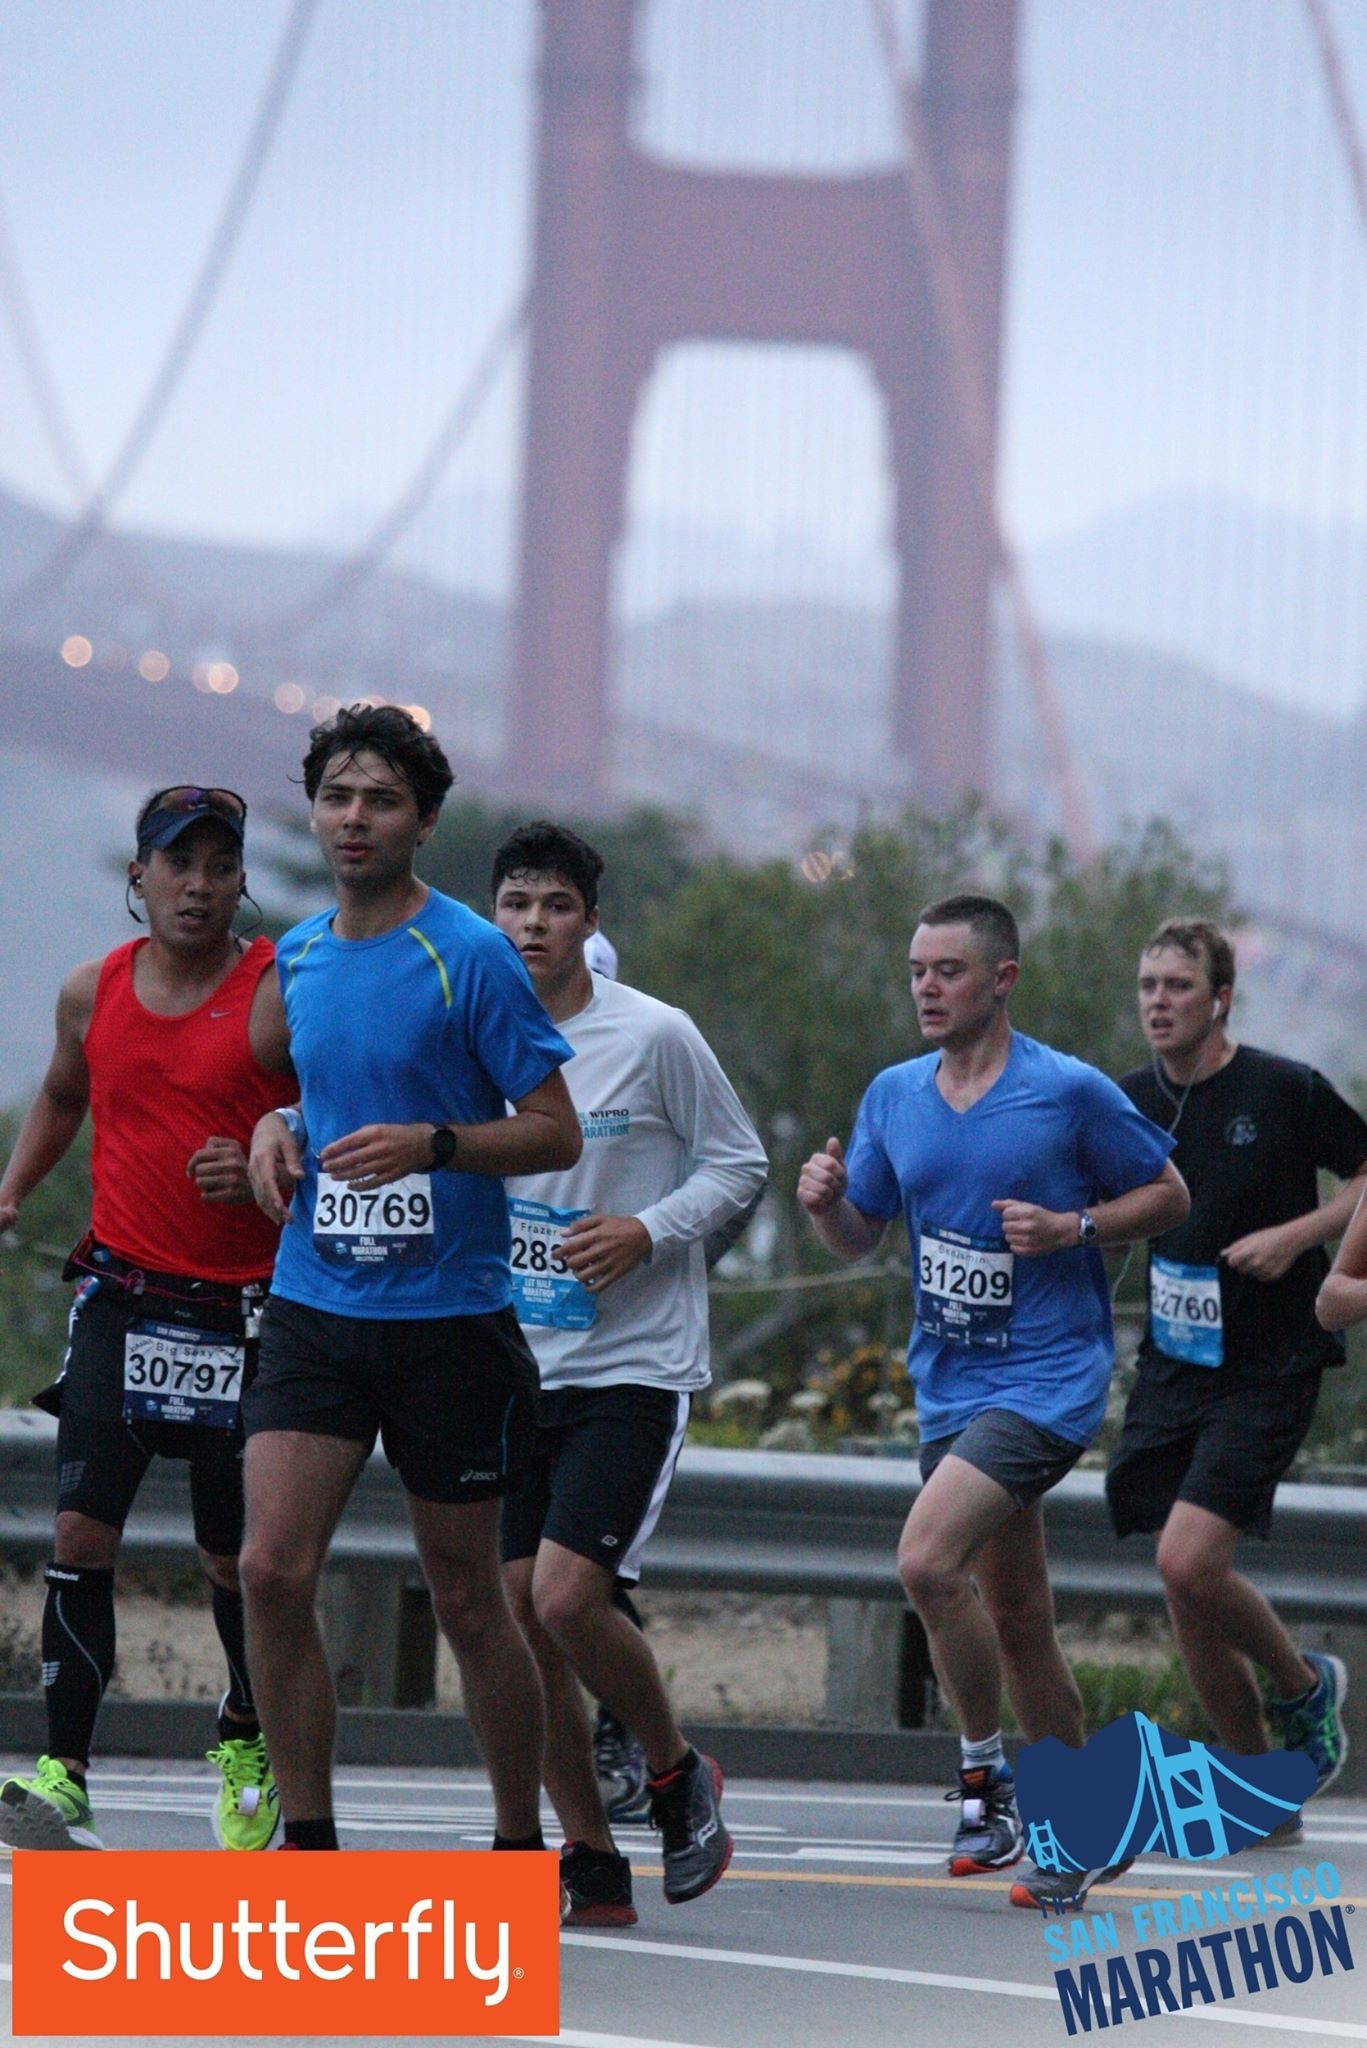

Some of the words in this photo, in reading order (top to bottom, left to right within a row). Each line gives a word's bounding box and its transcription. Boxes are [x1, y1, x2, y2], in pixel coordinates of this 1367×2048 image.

[589, 1109, 630, 1119] WIPRO
[583, 1123, 630, 1138] ARATHON
[317, 1193, 431, 1228] 30769
[520, 1222, 557, 1236] Frazer
[359, 1236, 376, 1246] FULL
[511, 1237, 569, 1274] 283
[920, 1255, 1011, 1300] 31209
[155, 1342, 178, 1356] Big
[183, 1346, 215, 1360] Sexy
[128, 1353, 240, 1395] 30797
